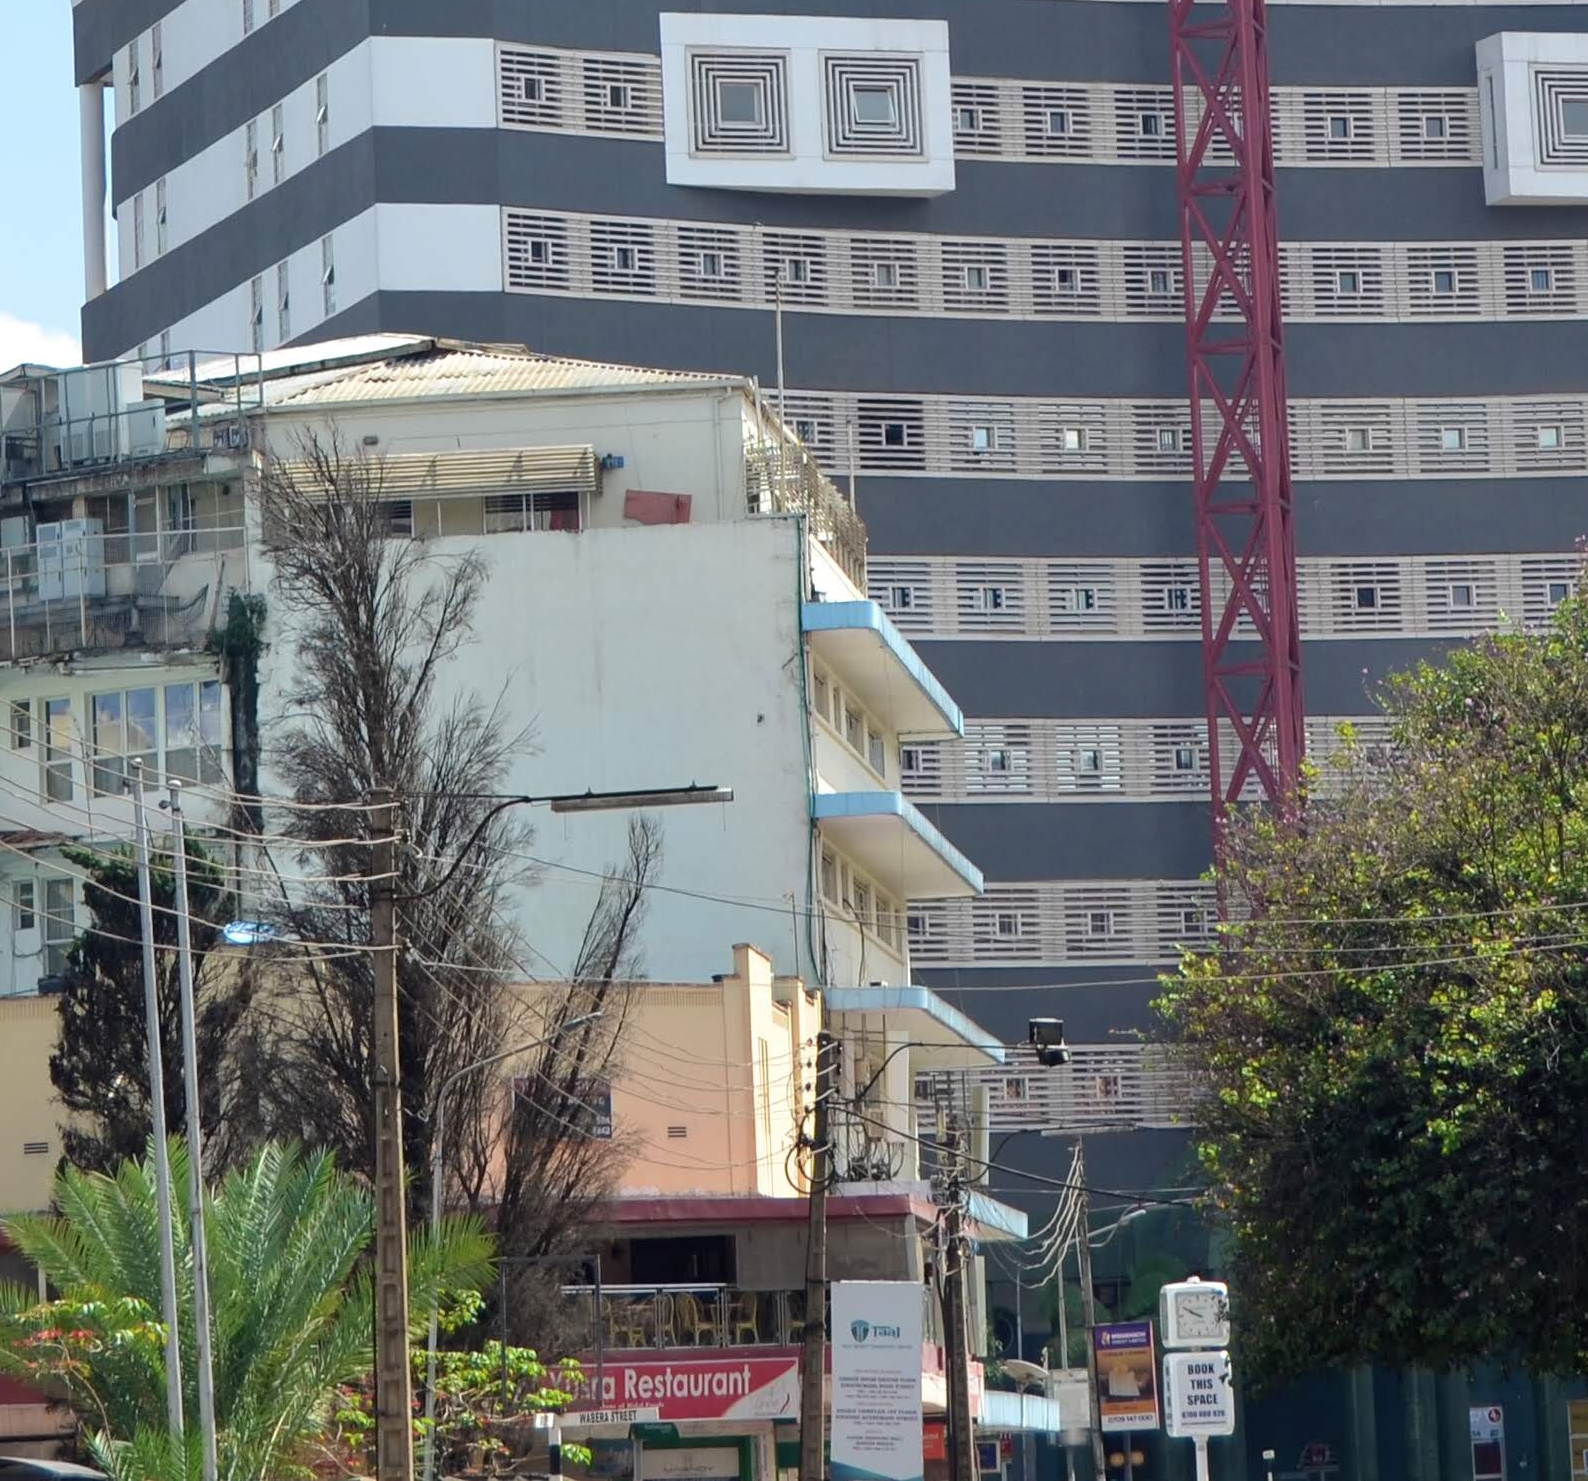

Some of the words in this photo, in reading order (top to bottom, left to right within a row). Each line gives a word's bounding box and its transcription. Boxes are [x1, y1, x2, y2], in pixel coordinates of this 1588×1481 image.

[1187, 1364, 1214, 1375] BOOK
[624, 1364, 751, 1400] Restaurant
[1191, 1379, 1213, 1390] THIS
[1187, 1393, 1218, 1405] SPACE
[580, 1412, 608, 1424] WABERA
[610, 1410, 636, 1422] STREET
